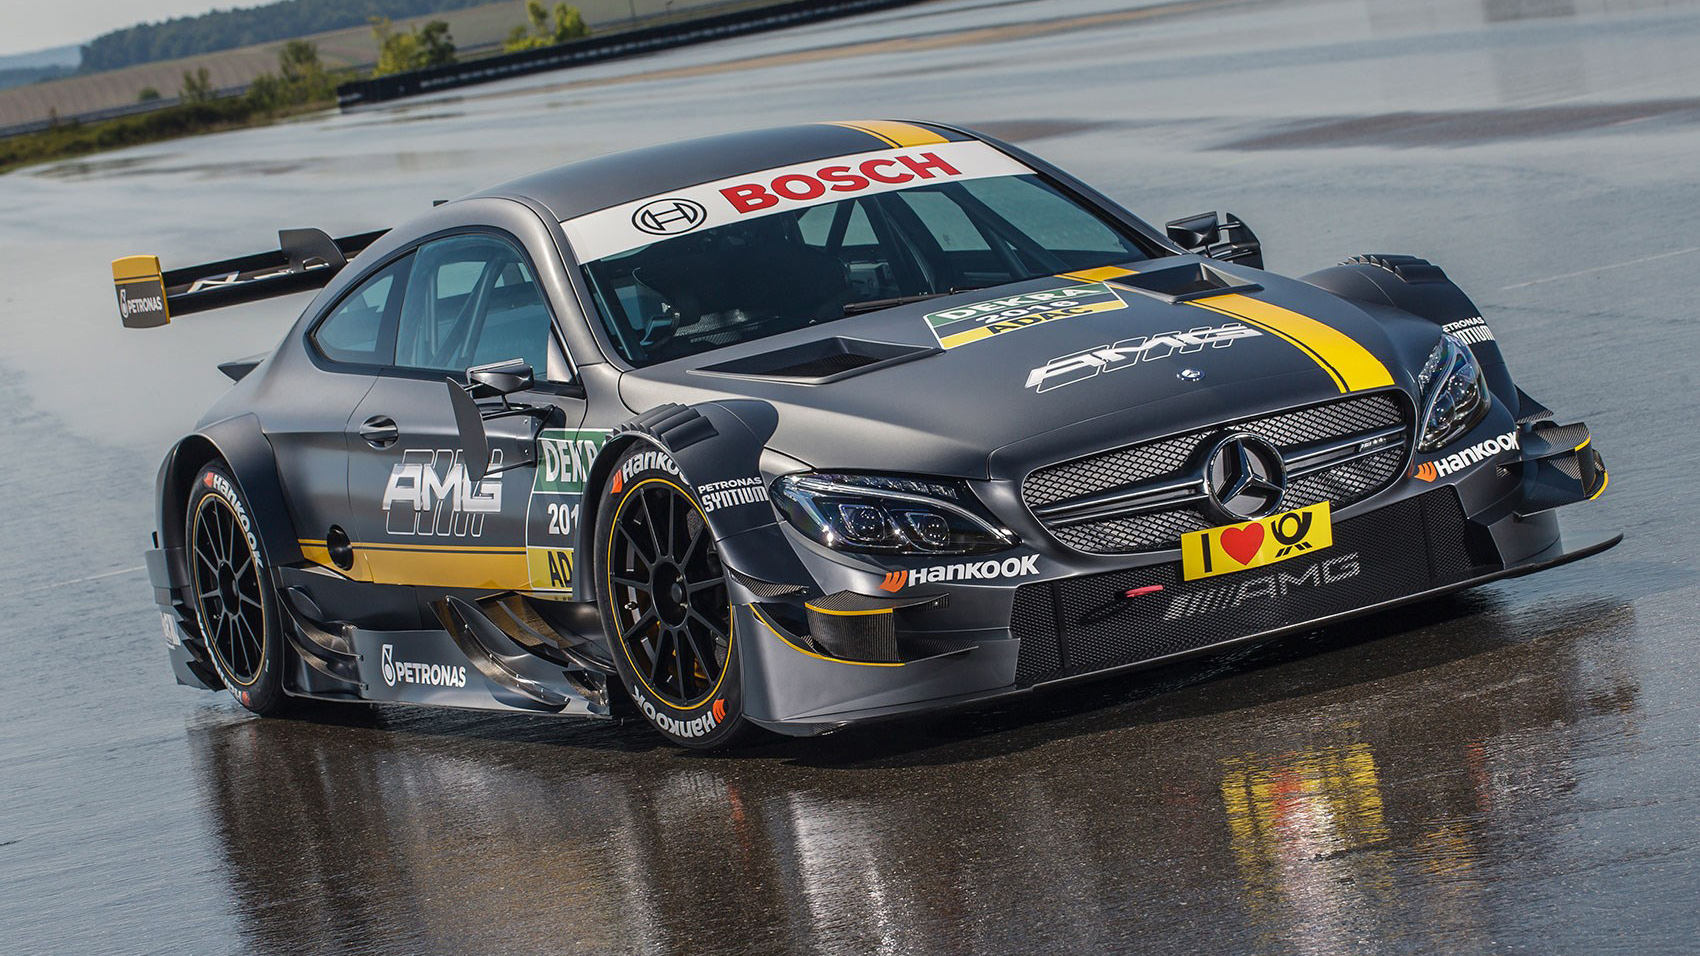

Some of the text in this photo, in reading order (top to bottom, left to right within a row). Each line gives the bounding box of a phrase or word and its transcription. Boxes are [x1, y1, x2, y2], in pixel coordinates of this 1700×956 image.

[719, 152, 962, 214] BOSCH
[128, 296, 163, 314] PETRONAS
[935, 288, 1101, 321] DEKRA
[975, 300, 1079, 324] 2016
[986, 307, 1093, 335] ADAC
[1442, 316, 1485, 333] ETRONAS
[1453, 325, 1496, 345] NTIUM
[541, 440, 606, 483] DEKR
[382, 463, 503, 512] AMG
[697, 476, 762, 495] PETRONAS
[702, 486, 770, 513] SYNTIUM
[547, 503, 580, 535] 201
[1201, 533, 1213, 573] I
[547, 550, 575, 588] AD
[395, 661, 467, 688] PETRONAS
